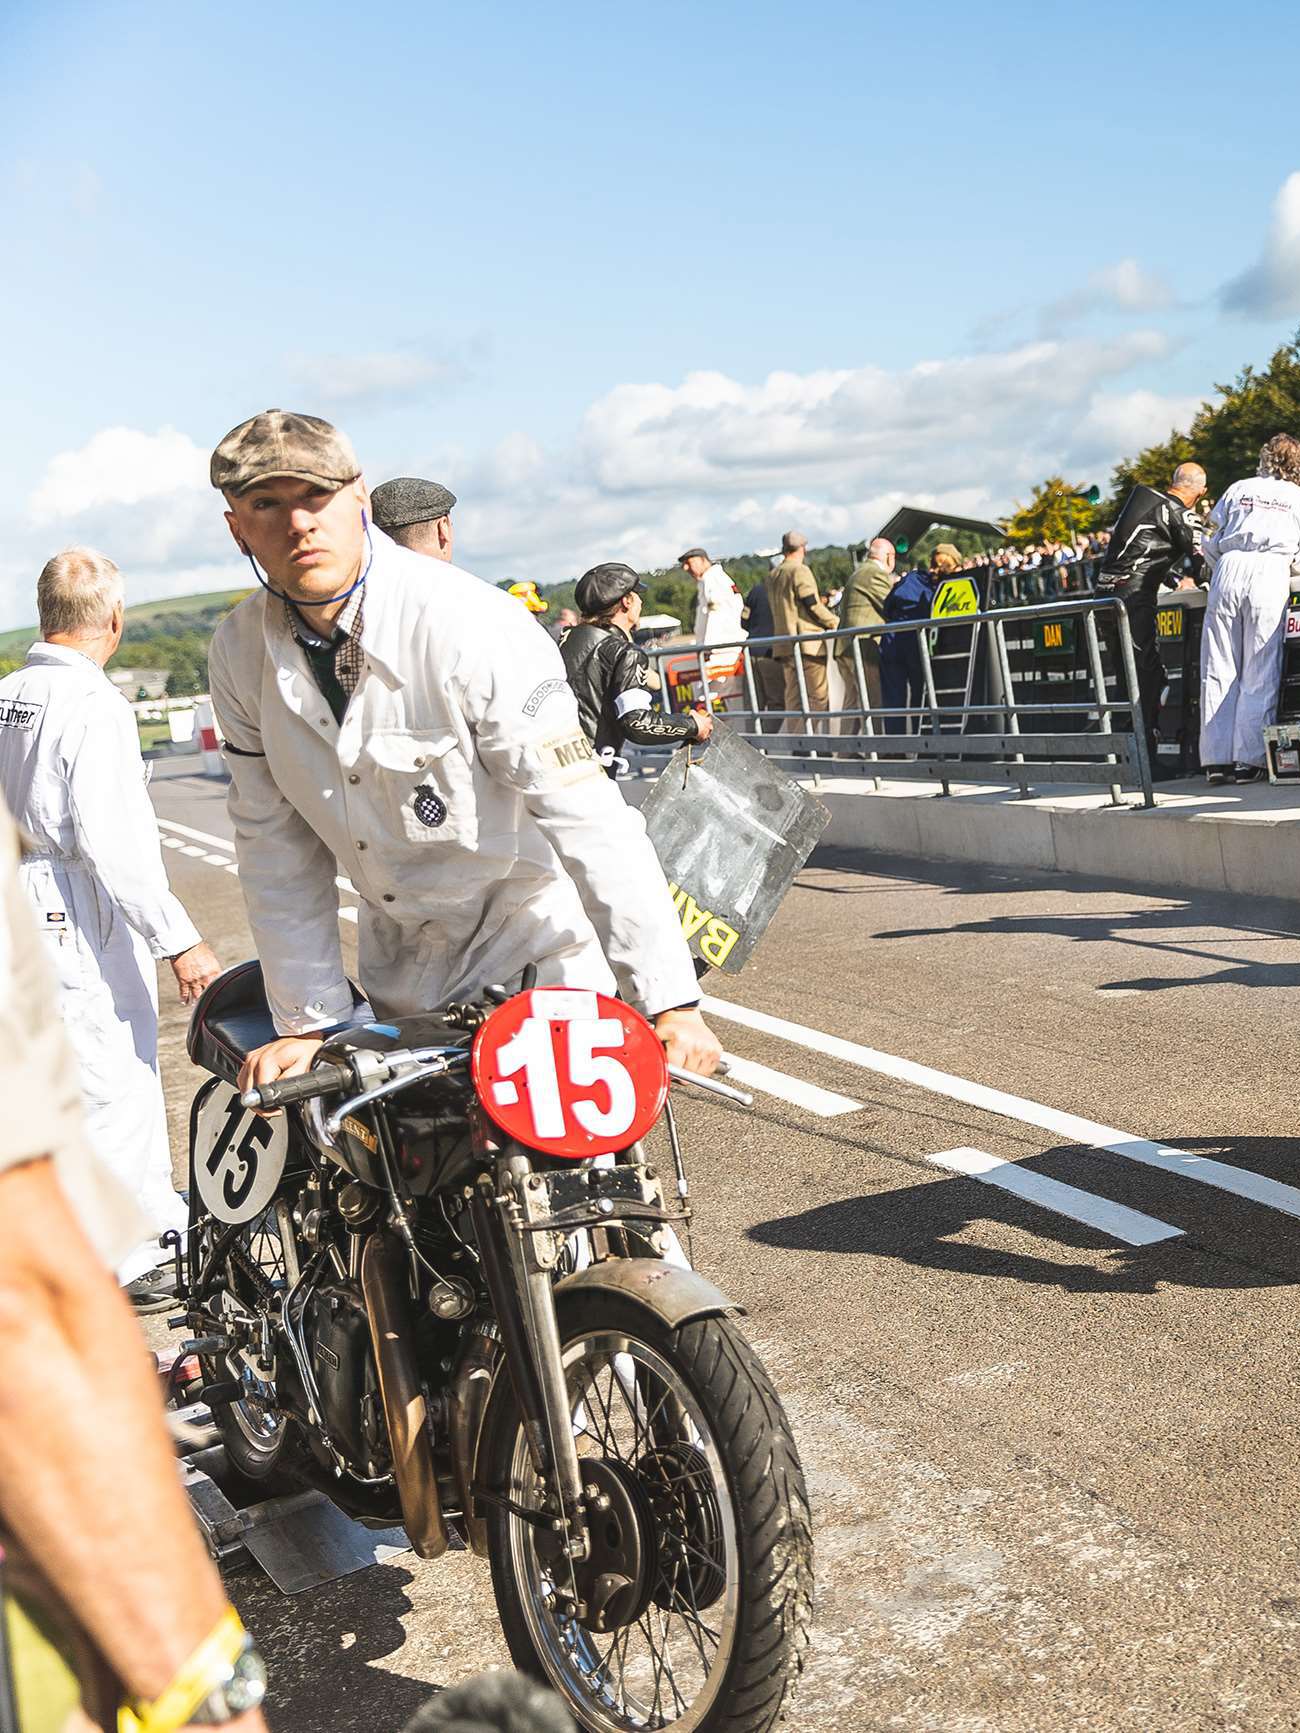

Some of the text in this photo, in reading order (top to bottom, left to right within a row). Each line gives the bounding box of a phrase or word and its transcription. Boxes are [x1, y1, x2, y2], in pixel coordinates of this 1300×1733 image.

[1043, 624, 1062, 648] DAN
[1155, 609, 1182, 637] REW
[668, 880, 741, 958] BA
[494, 1018, 637, 1138] 15
[205, 1092, 274, 1210] 15
